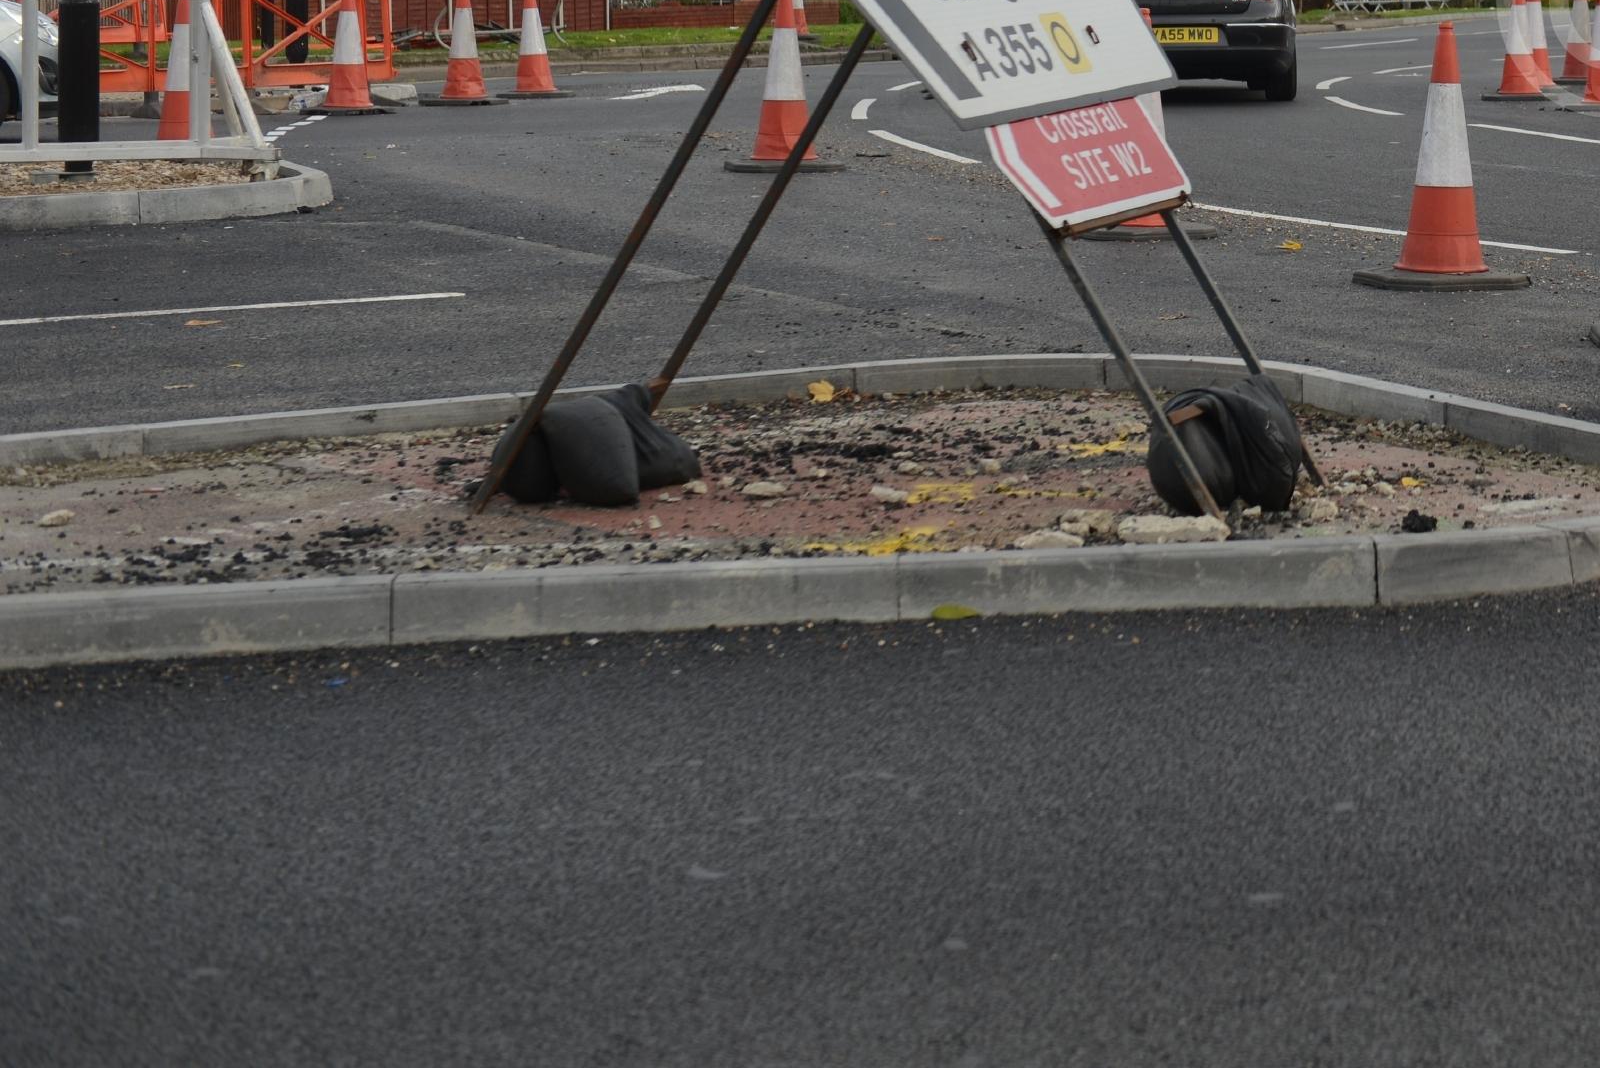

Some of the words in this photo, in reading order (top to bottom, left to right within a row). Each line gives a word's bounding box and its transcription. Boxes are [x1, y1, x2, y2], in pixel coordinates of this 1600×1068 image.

[962, 23, 1053, 81] A355
[1034, 102, 1128, 144] Crossrail
[1060, 147, 1119, 190] SITE
[1109, 140, 1153, 178] W2
